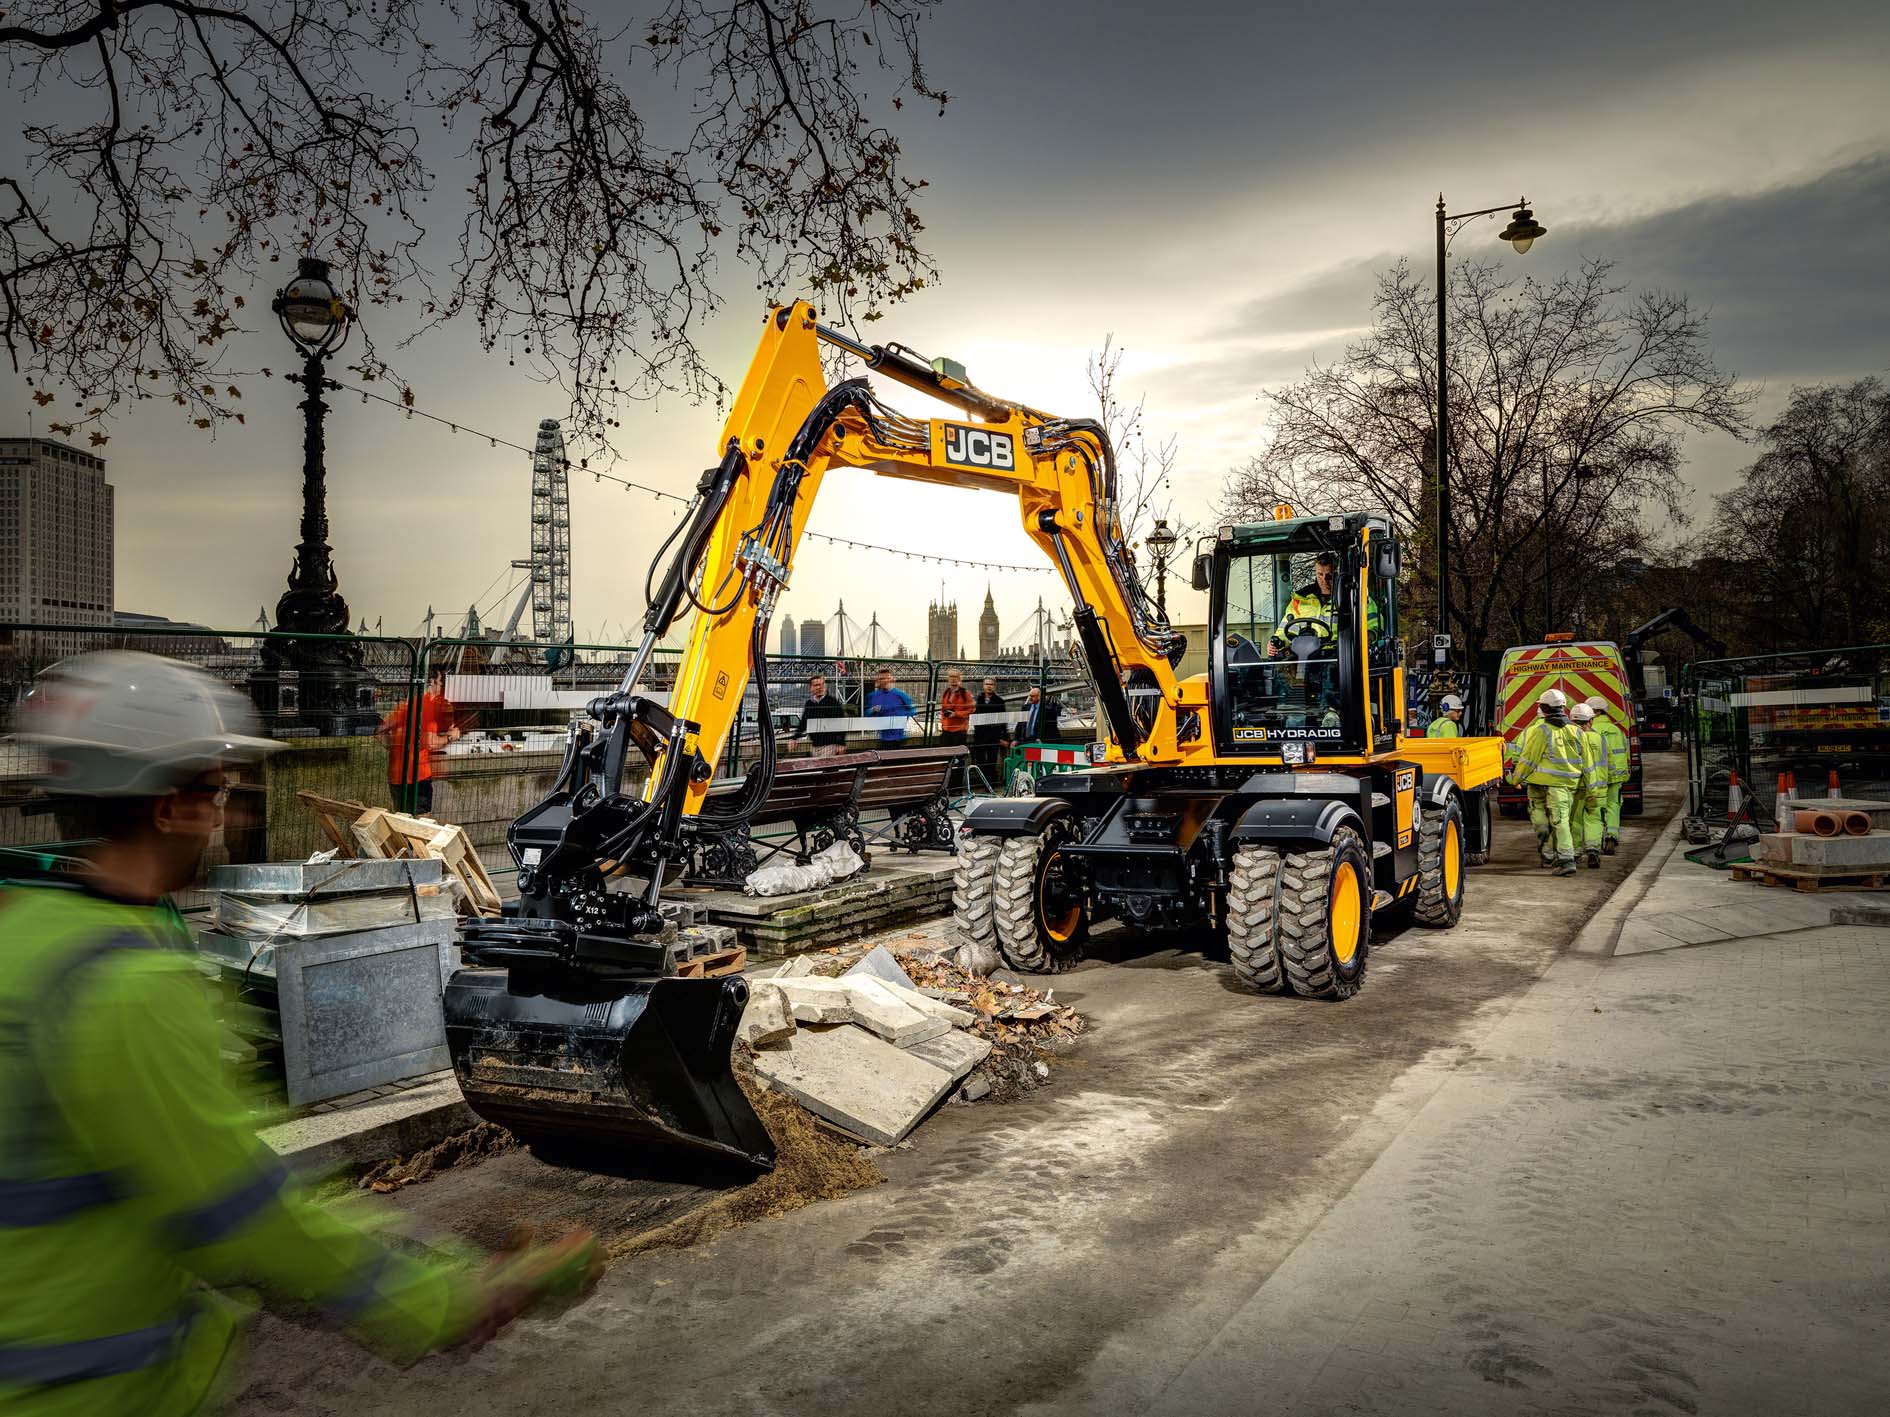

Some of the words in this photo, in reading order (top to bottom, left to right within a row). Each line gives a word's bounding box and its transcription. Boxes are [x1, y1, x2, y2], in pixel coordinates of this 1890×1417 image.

[947, 428, 1013, 468] JCB
[1513, 663, 1550, 672] HIGHWAY
[1551, 660, 1609, 670] MAINTENANCE
[1236, 730, 1264, 738] JCB
[1267, 729, 1341, 738] HYDRADIG
[1397, 773, 1412, 791] JCB
[585, 906, 599, 914] X12
